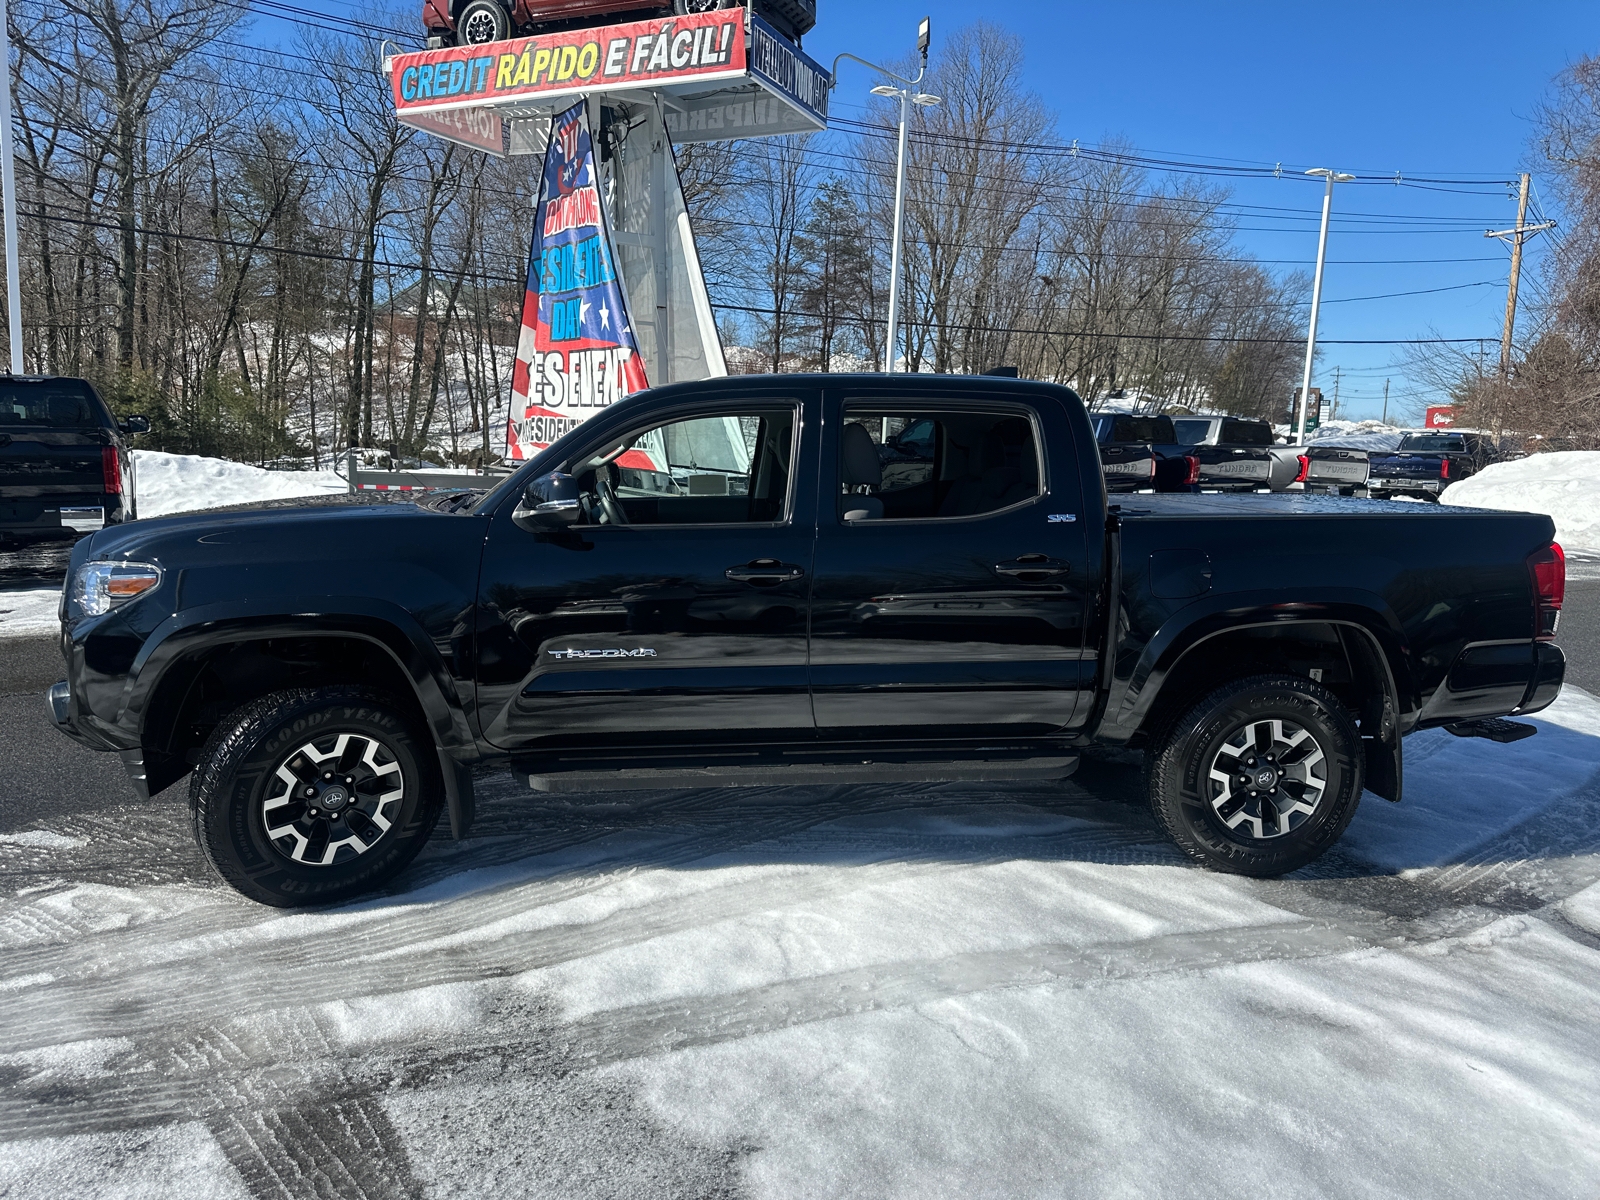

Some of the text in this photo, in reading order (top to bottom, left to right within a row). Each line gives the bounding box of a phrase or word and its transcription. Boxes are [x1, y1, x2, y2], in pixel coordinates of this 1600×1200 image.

[402, 23, 731, 101] CREDIT RÁPIDO E FÁCIL!
[794, 57, 814, 107] YOUR
[813, 71, 829, 118] CAR
[551, 299, 581, 341] DAY
[567, 347, 632, 408] EVENT
[1217, 464, 1258, 473] TUNDRA
[1325, 465, 1358, 475] TUNDRA
[548, 647, 658, 659] TACOMA
